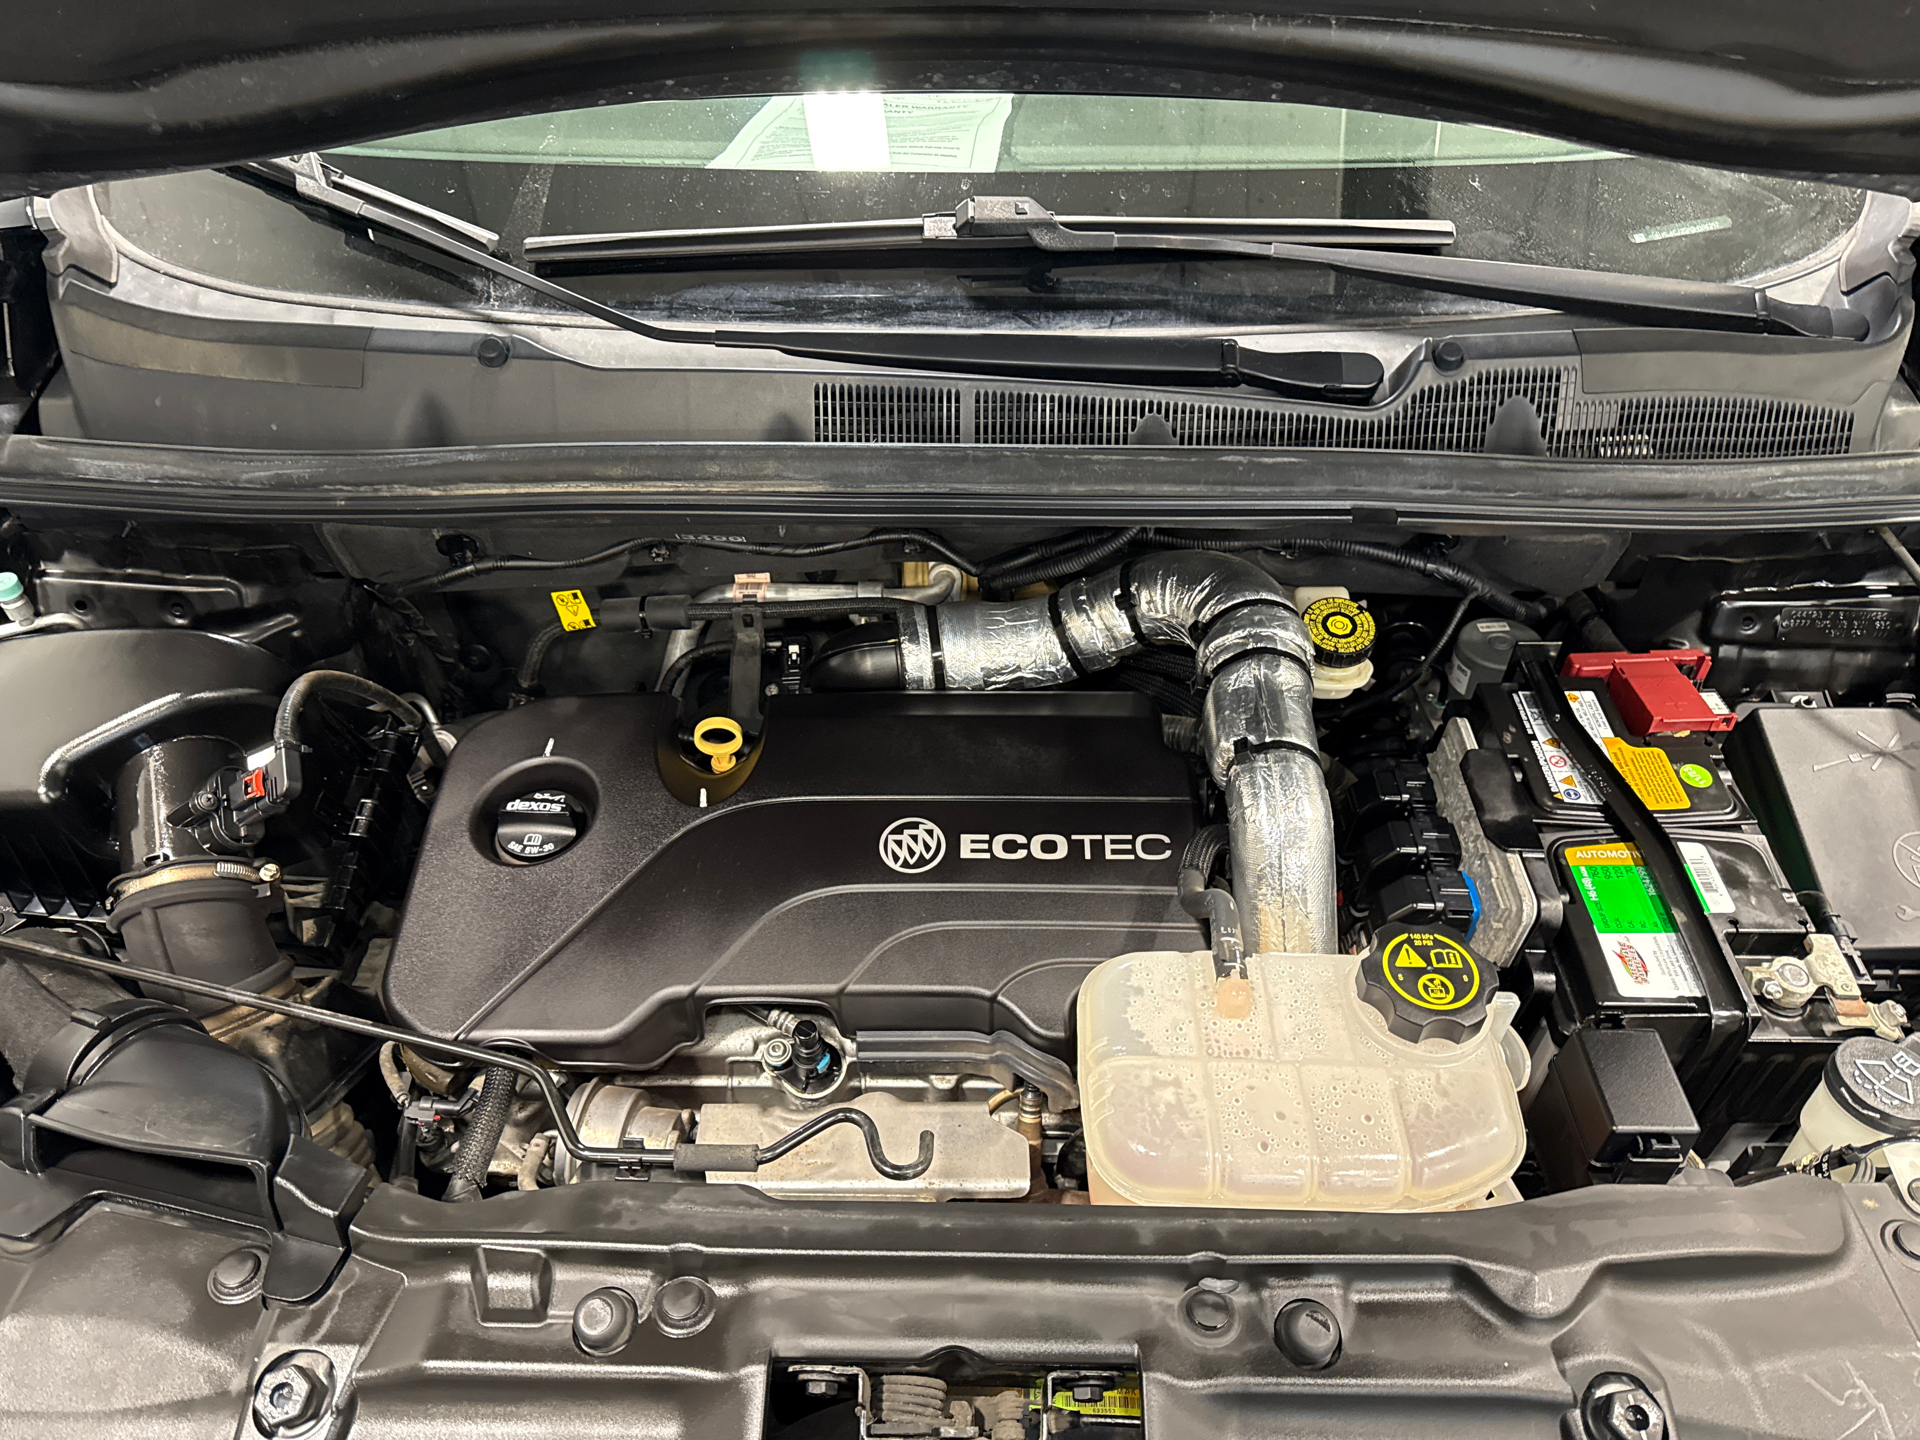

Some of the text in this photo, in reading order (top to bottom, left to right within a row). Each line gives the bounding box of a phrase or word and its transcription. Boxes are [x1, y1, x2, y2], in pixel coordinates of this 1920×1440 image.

[1684, 766, 1707, 785] 11/23
[505, 799, 562, 812] dexos
[507, 841, 555, 854] SAE 5W-30
[959, 833, 1172, 860] ECOTEC
[1588, 866, 1601, 880] 760
[1612, 866, 1625, 879] 120
[1624, 866, 1635, 875] 70
[1587, 889, 1599, 901] H6
[1618, 942, 1644, 985] INTERSTATE
[1627, 945, 1650, 984] BATTERIES
